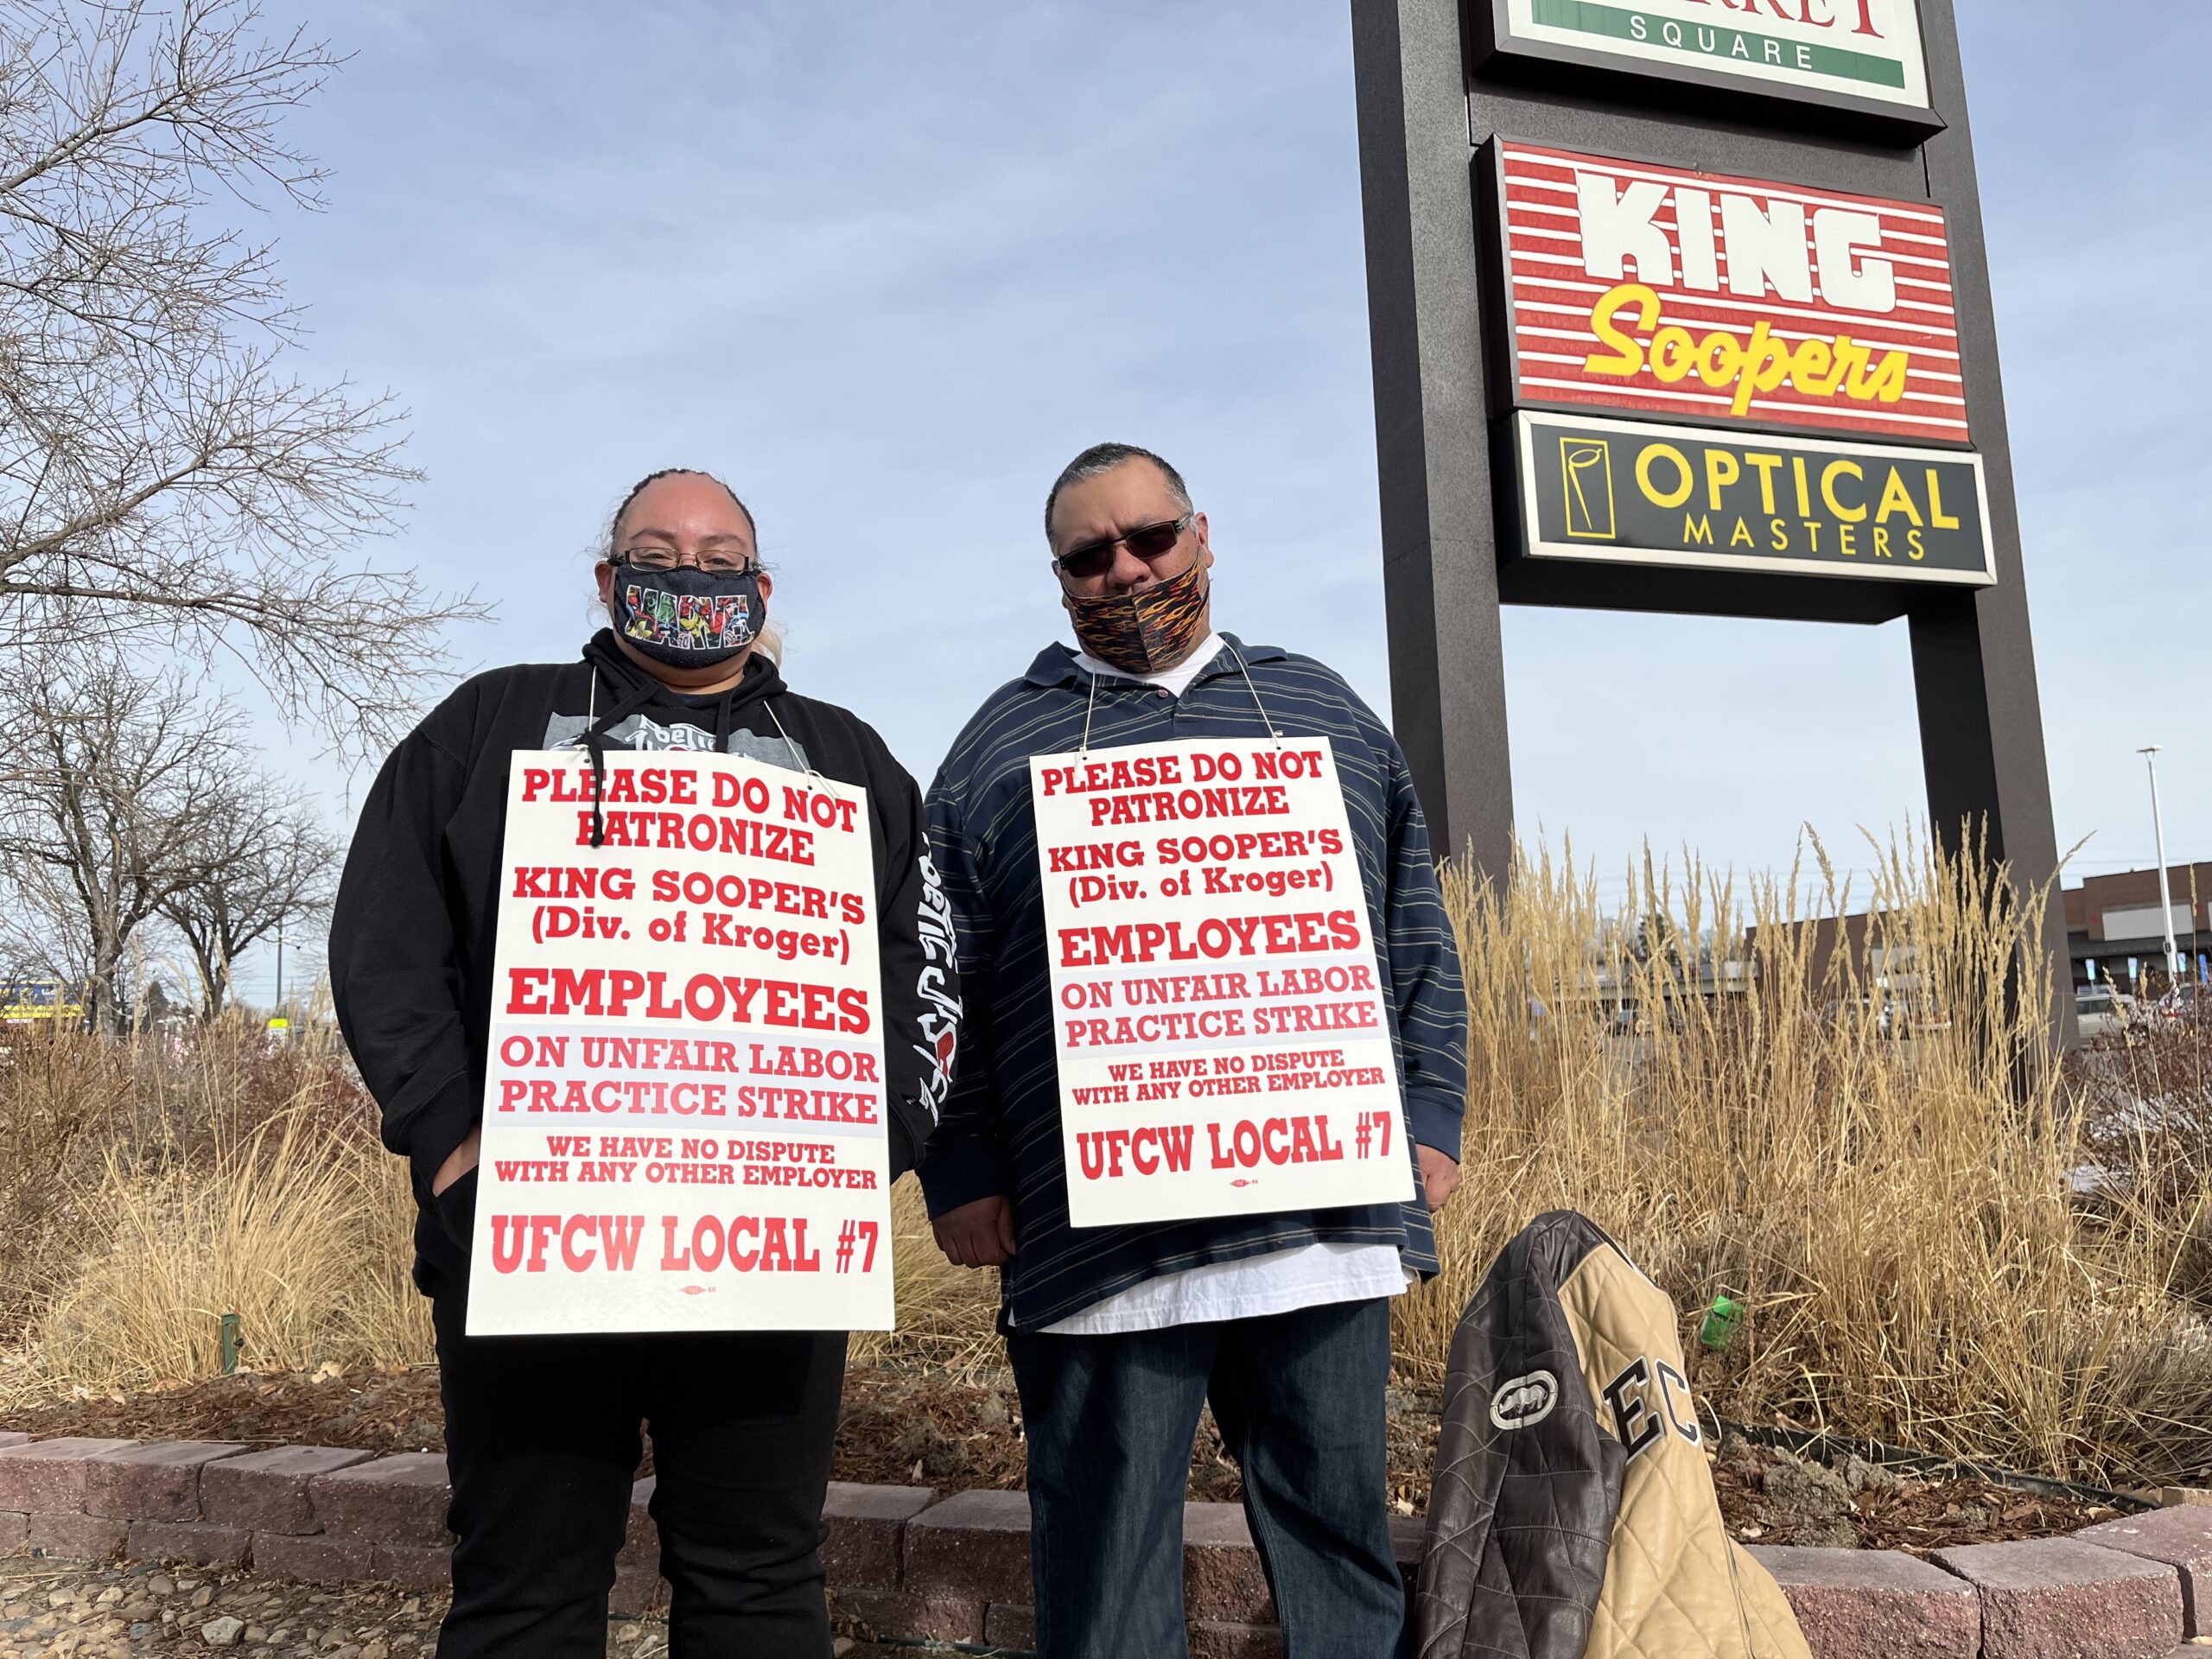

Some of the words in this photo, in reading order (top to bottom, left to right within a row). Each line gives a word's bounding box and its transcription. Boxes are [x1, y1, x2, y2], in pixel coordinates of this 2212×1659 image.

[1630, 15, 1812, 69] SQUARE
[1574, 168, 1897, 313] KING
[1584, 283, 1909, 416] Soopers
[1635, 443, 1960, 530] OPTICAL
[1683, 513, 1925, 561] MASTERS
[625, 584, 755, 650] MARVEL
[1040, 754, 1183, 798] PLEASE
[1189, 752, 1243, 783] DO
[1250, 750, 1323, 780] NOT
[521, 767, 698, 805] PLEASE
[711, 771, 771, 815] DO
[782, 785, 858, 834] NOT
[1088, 785, 1290, 827] PATRONIZE
[1047, 840, 1146, 874] KING
[1156, 829, 1344, 865] SOOPER'S
[512, 866, 637, 901] KING
[652, 869, 866, 925] SOOPER'S
[1069, 874, 1147, 909] (Div.
[1160, 868, 1192, 898] of
[1202, 860, 1333, 898] Kroger)
[531, 905, 631, 944] (Div.
[648, 910, 688, 943] of
[702, 912, 850, 966] Kroger)
[1057, 909, 1361, 968] EMPLOYEES
[505, 967, 871, 1035] EMPLOYEES
[1061, 981, 1113, 1010] ON
[1122, 972, 1252, 1007] UNFAIR
[1256, 964, 1376, 997] LABOR
[1065, 1008, 1246, 1048] PRACTICE
[1253, 1001, 1378, 1035] STRIKE
[499, 1035, 570, 1068] ON
[581, 1036, 740, 1073] UNFAIR
[748, 1043, 880, 1084] LABOR
[1107, 1063, 1144, 1083] WE
[1149, 1058, 1208, 1080] HAVE
[1213, 1055, 1245, 1075] NO
[1251, 1049, 1345, 1073] DISPUTE
[498, 1079, 727, 1116] PRACTICE
[738, 1085, 879, 1125] STRIKE
[1071, 1084, 1130, 1106] WITH
[1135, 1080, 1181, 1102] ANY
[1188, 1075, 1262, 1098] OTHER
[1267, 1066, 1385, 1092] EMPLOYER
[546, 1135, 591, 1158] WE
[600, 1136, 673, 1159] HAVE
[681, 1138, 719, 1160] NO
[728, 1140, 836, 1165] DISPUTE
[1076, 1124, 1195, 1181] UFCW
[1206, 1114, 1344, 1170] LOCAL
[1355, 1110, 1392, 1159] #7
[494, 1160, 569, 1183] WITH
[577, 1160, 637, 1183] ANY
[645, 1161, 735, 1185] OTHER
[743, 1164, 877, 1190] EMPLOYER
[490, 1213, 645, 1274] UFCW
[660, 1214, 821, 1273] LOCAL
[836, 1219, 879, 1274] #7
